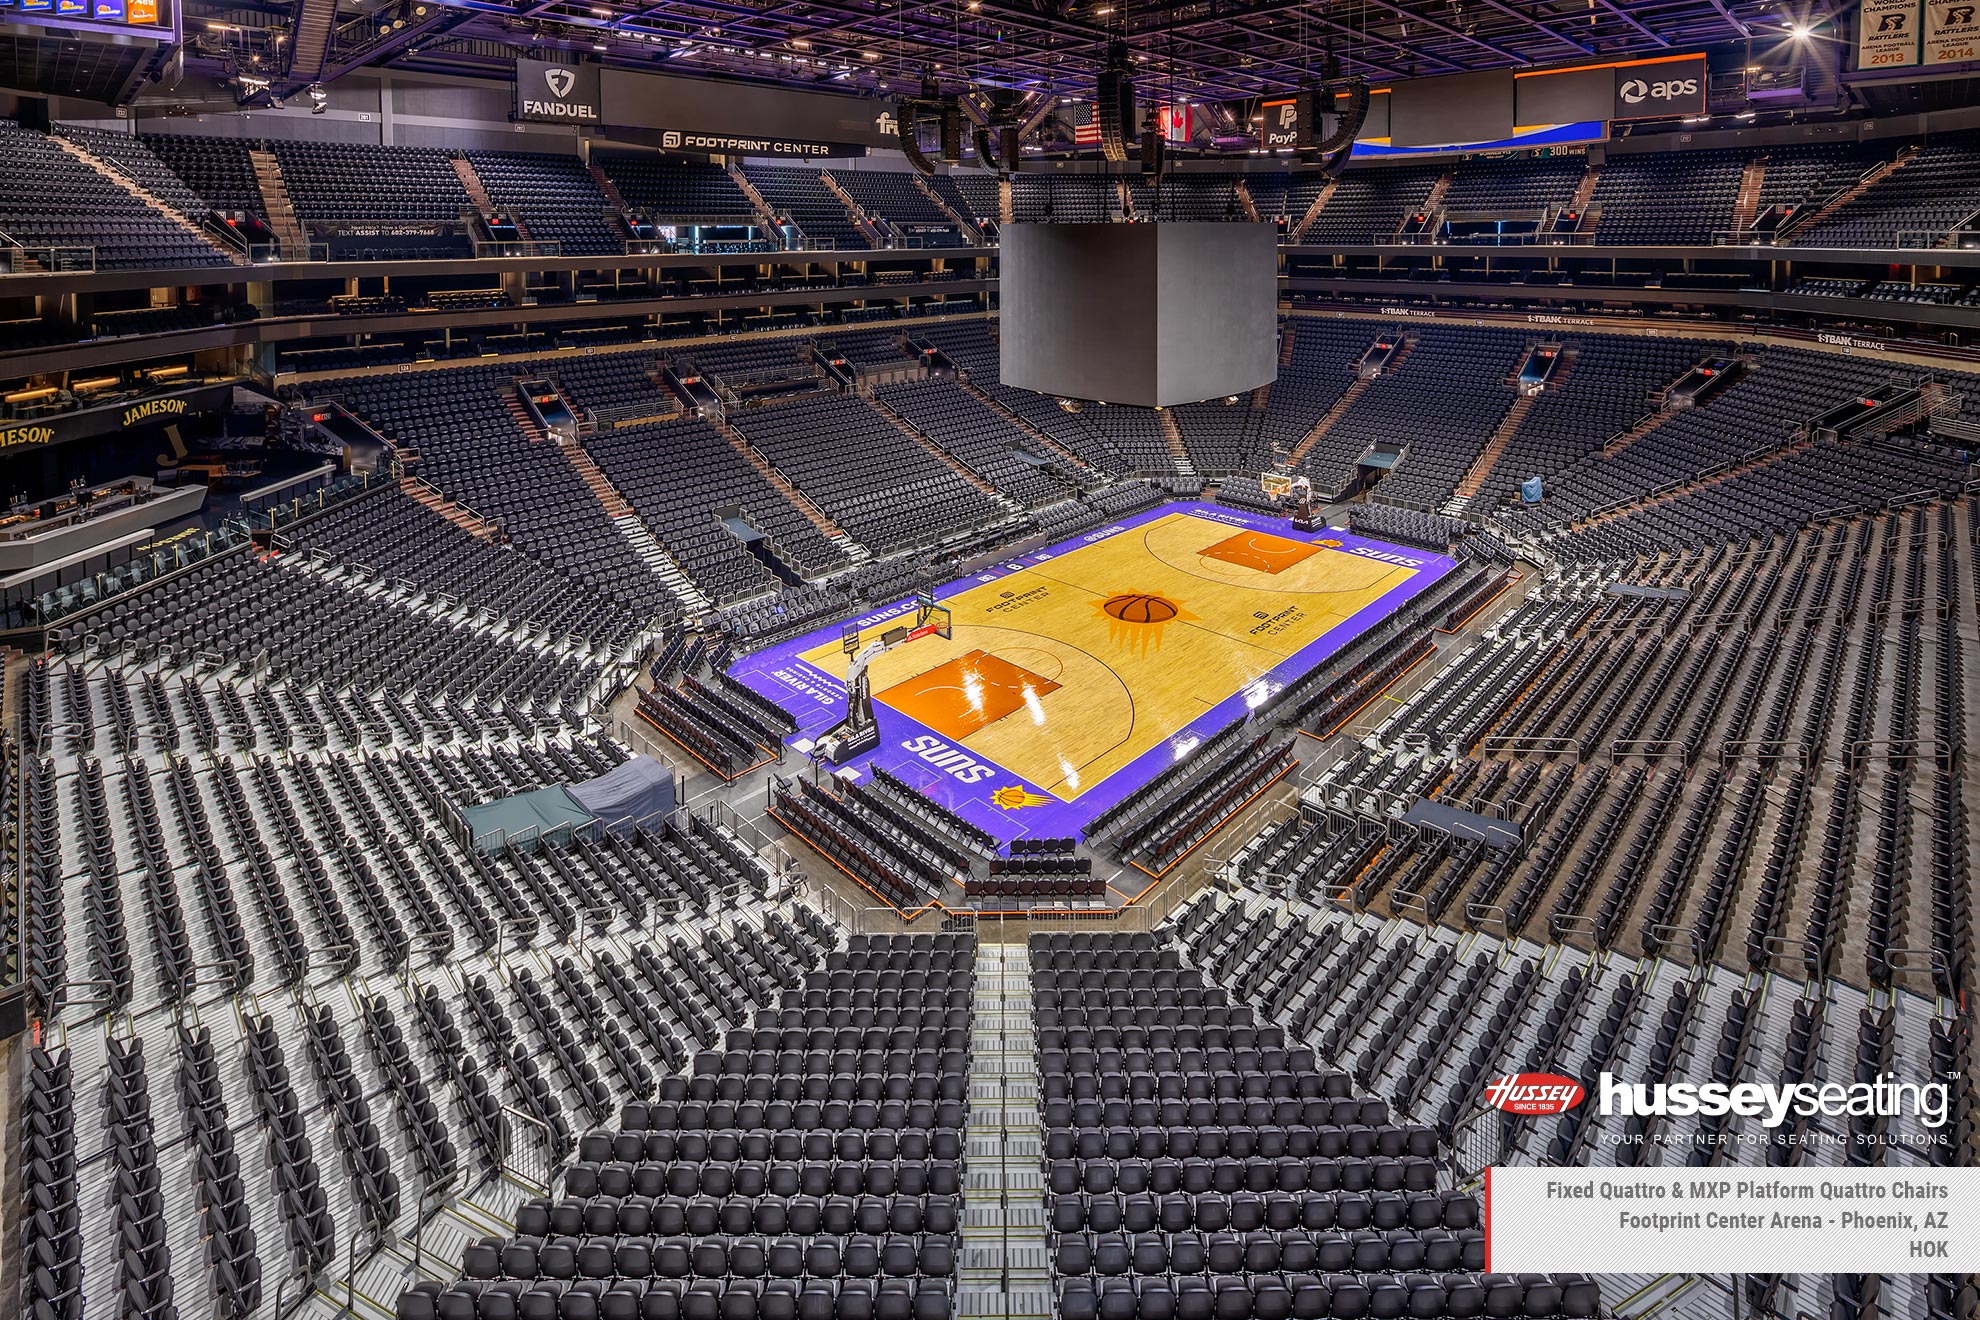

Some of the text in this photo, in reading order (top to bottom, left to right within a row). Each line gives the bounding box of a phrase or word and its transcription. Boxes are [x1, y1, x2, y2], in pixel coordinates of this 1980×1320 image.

[1863, 2, 1916, 13] CHAMPIONS
[1867, 32, 1910, 41] RATTLERS
[1933, 25, 1980, 36] RATTLERS
[1871, 53, 1904, 64] 2013
[1937, 47, 1974, 60] 2014
[1650, 79, 1698, 101] aps
[523, 100, 597, 118] FANDUEL
[685, 136, 829, 155] FOOTPRINT CENTER
[1269, 131, 1297, 144] PayP
[1549, 145, 1568, 156] 300
[1852, 339, 1885, 350] TERRACE
[122, 399, 187, 427] JAMESON
[1083, 525, 1126, 543] @SUNS
[1350, 547, 1424, 567] SUNS
[986, 586, 1048, 613] FOOTPRINT
[1002, 591, 1050, 613] CENTER
[857, 594, 936, 627] SUNS.CO
[1249, 605, 1298, 635] FOOTPRINT
[1267, 612, 1307, 635] CENTER
[773, 670, 835, 705] GILA RIVER
[901, 735, 996, 784] SUNS
